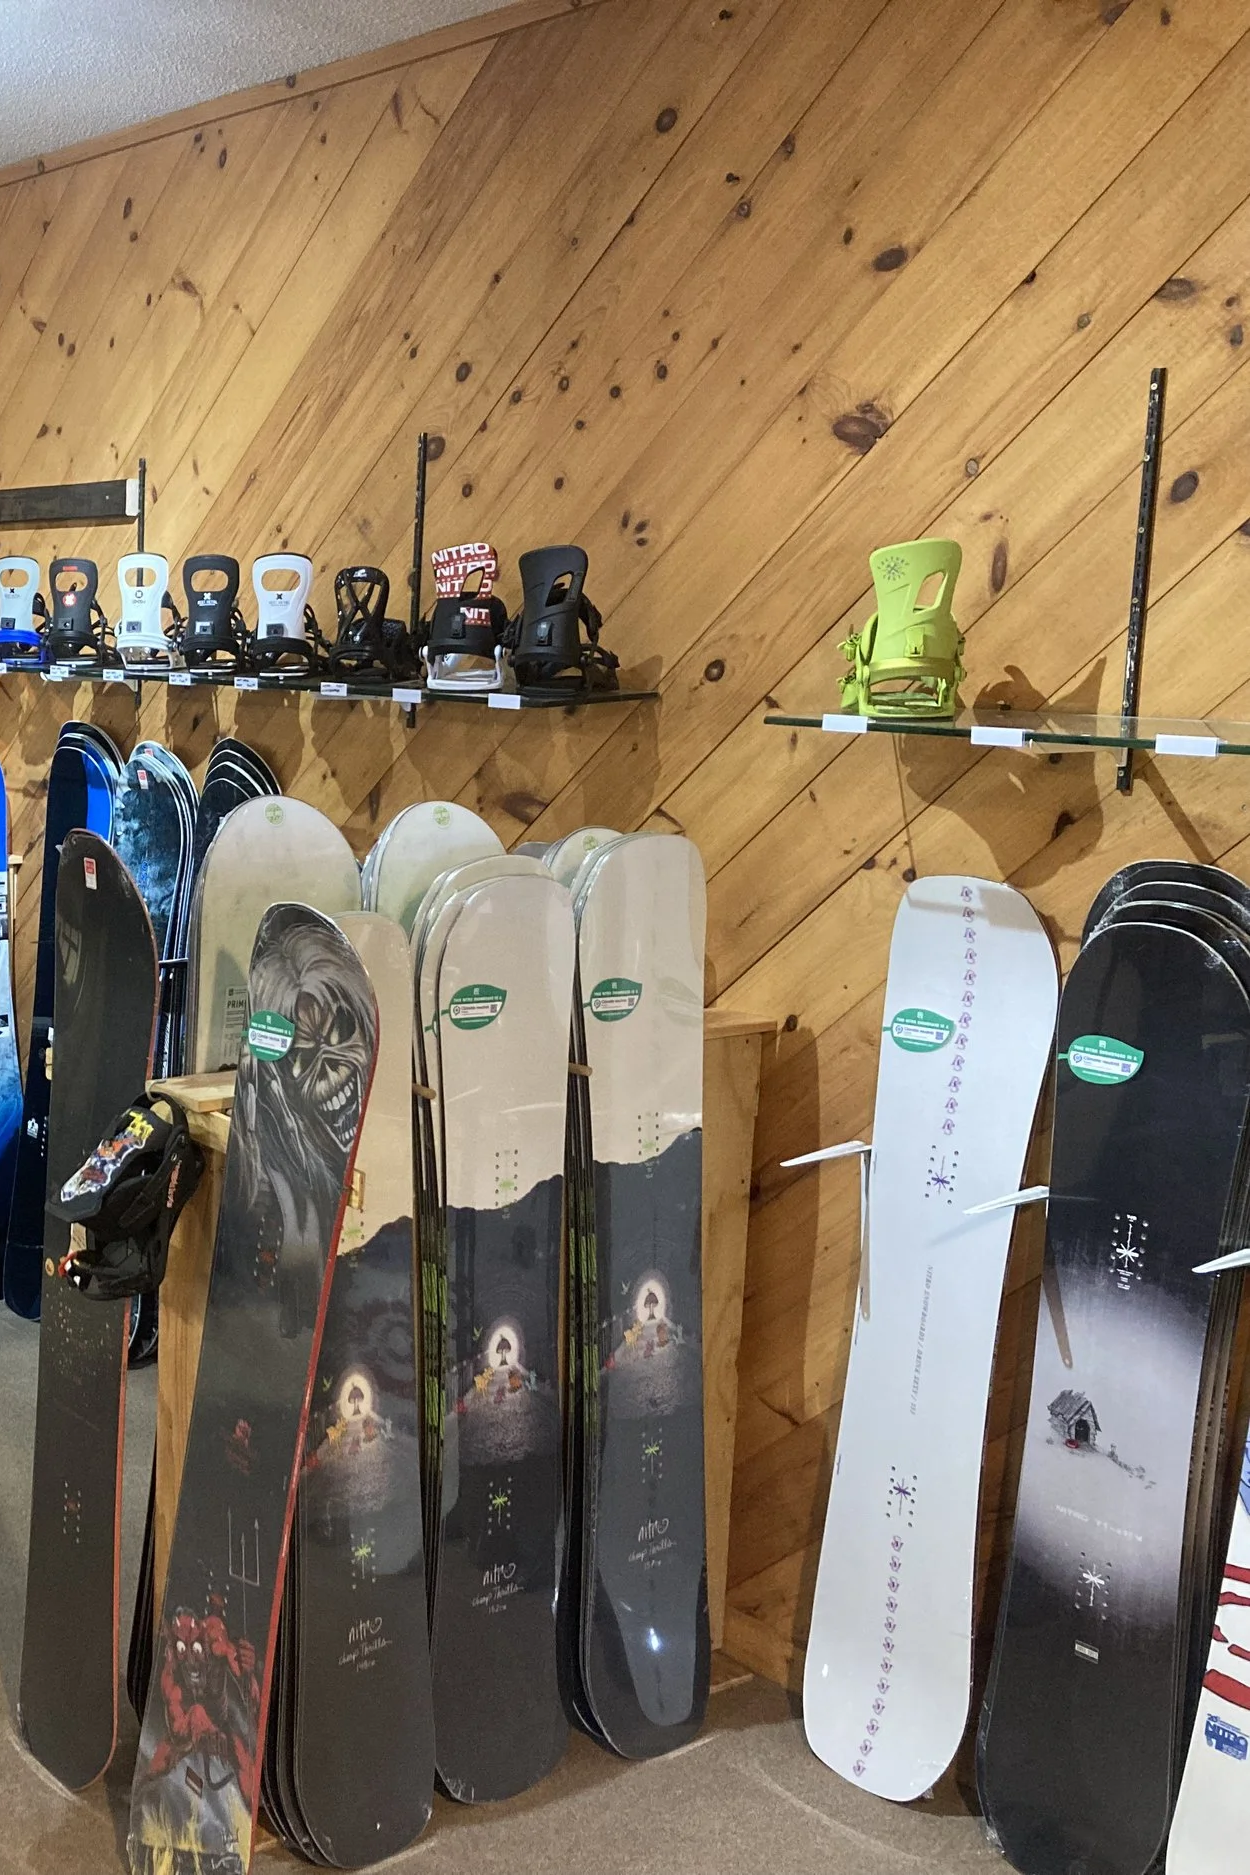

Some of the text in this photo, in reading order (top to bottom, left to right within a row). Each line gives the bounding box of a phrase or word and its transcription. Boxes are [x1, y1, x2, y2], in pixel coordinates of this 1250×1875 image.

[431, 542, 490, 564] NITRO
[436, 560, 496, 577] NITRO
[436, 579, 493, 593] NITO
[638, 1518, 669, 1543] nitro
[482, 1562, 516, 1587] nitro
[348, 1616, 383, 1645] nitro
